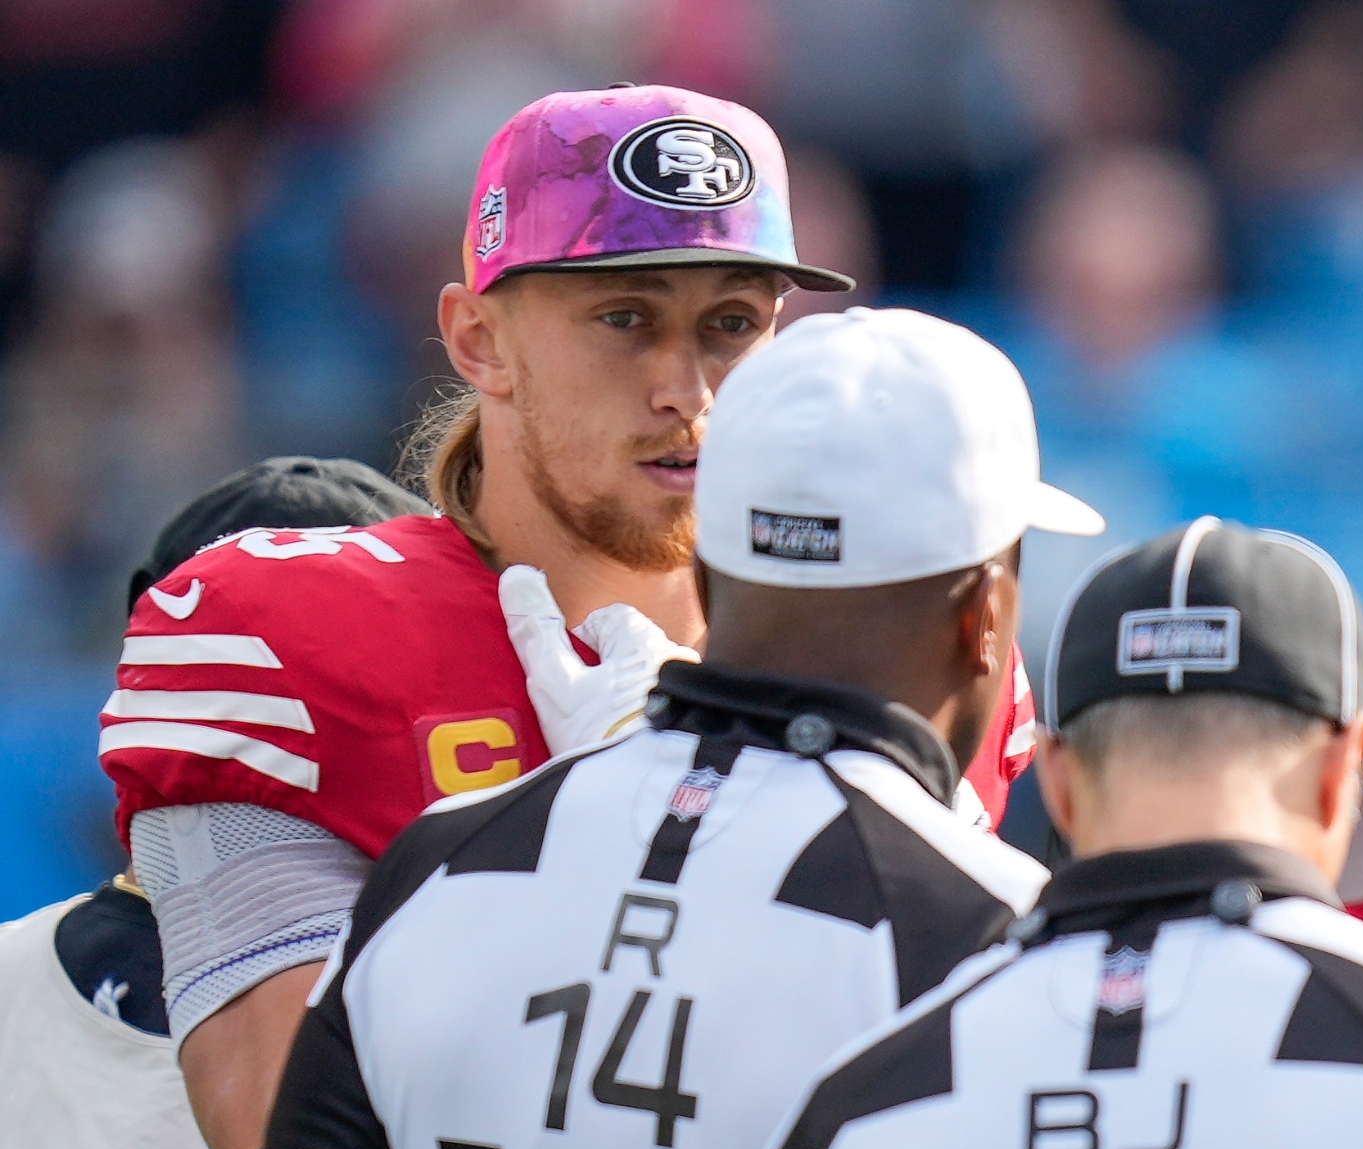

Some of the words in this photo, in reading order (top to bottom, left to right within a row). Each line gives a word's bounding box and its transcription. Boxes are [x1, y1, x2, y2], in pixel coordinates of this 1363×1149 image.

[655, 130, 741, 198] SF
[195, 524, 406, 563] 5
[426, 717, 522, 796] C
[603, 893, 679, 977] R
[525, 982, 697, 1148] 14
